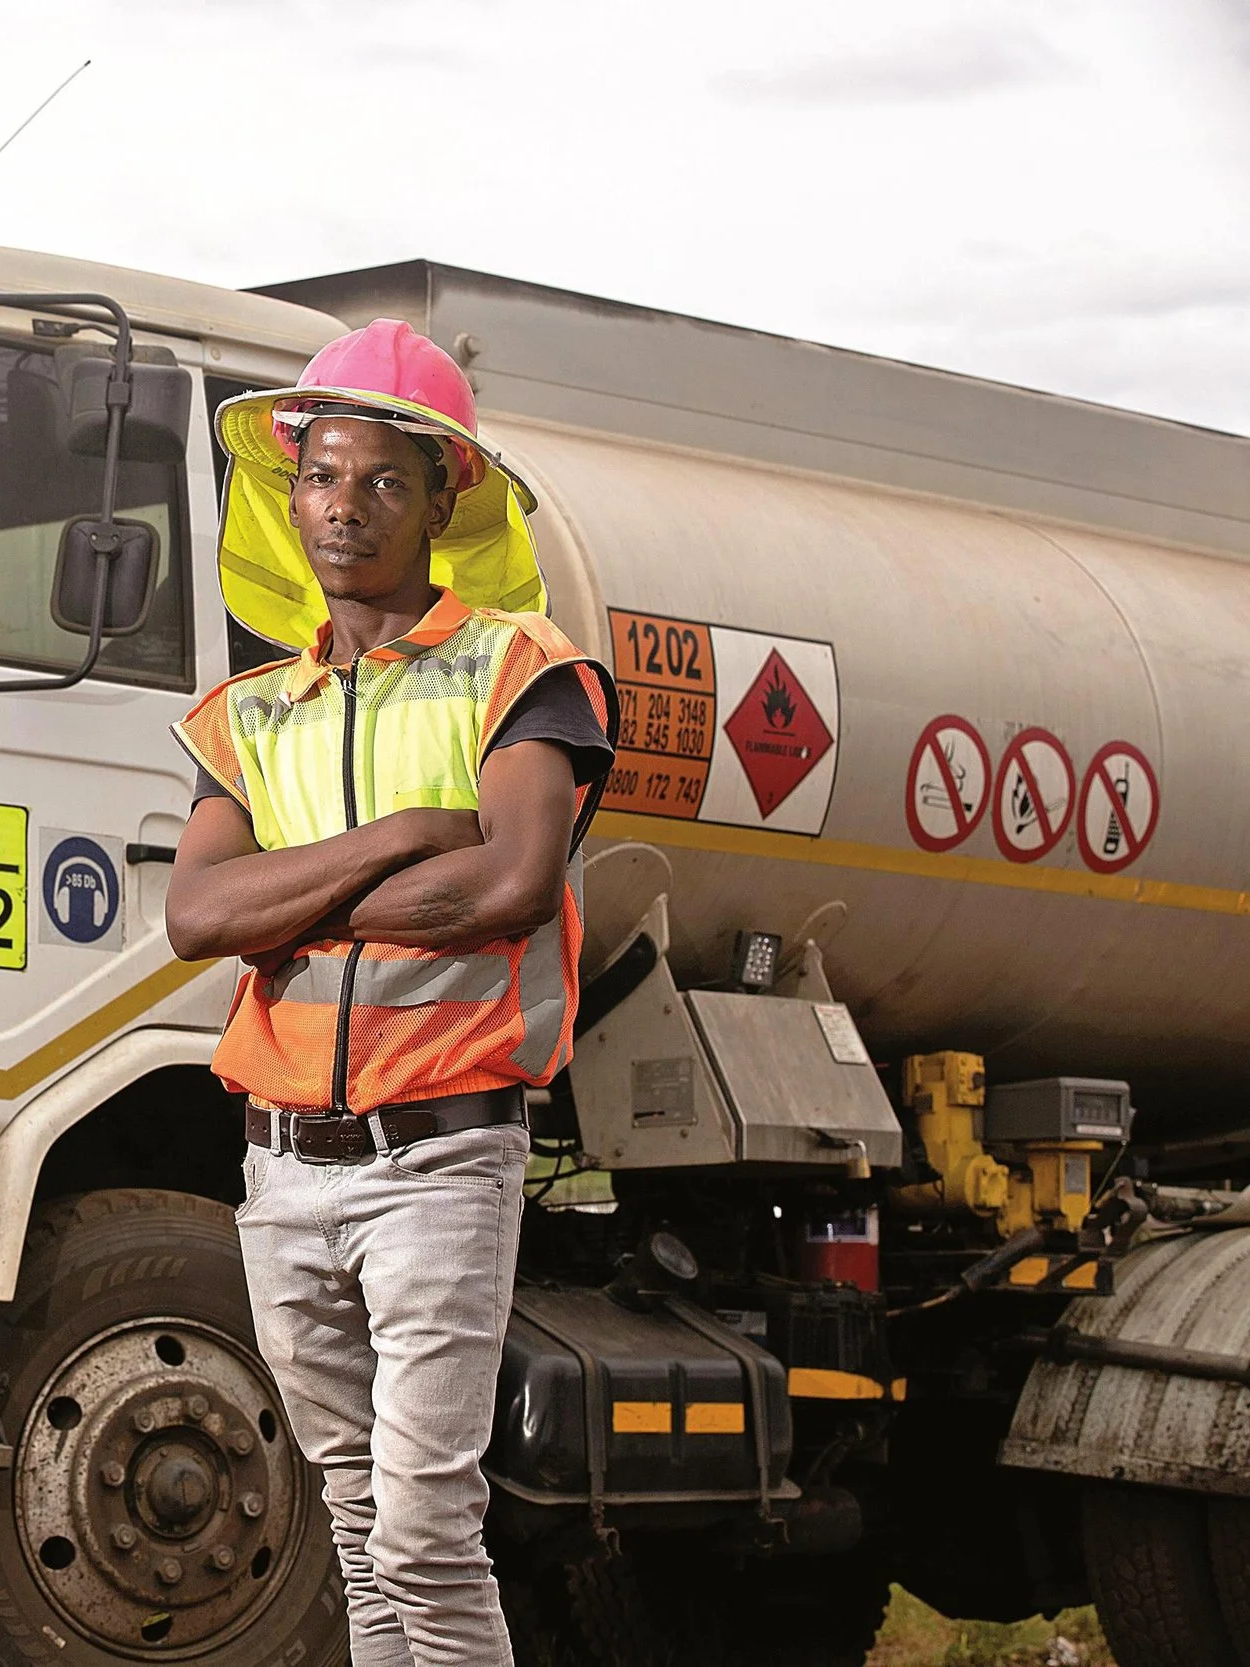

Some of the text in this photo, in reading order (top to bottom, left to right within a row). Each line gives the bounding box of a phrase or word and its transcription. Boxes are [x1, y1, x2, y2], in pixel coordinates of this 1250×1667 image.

[628, 619, 702, 681] 1202
[648, 693, 671, 721] 204
[678, 698, 707, 727] 3148
[644, 721, 669, 749] 545
[676, 727, 705, 755] 1030
[606, 767, 701, 804] 0800 172 743
